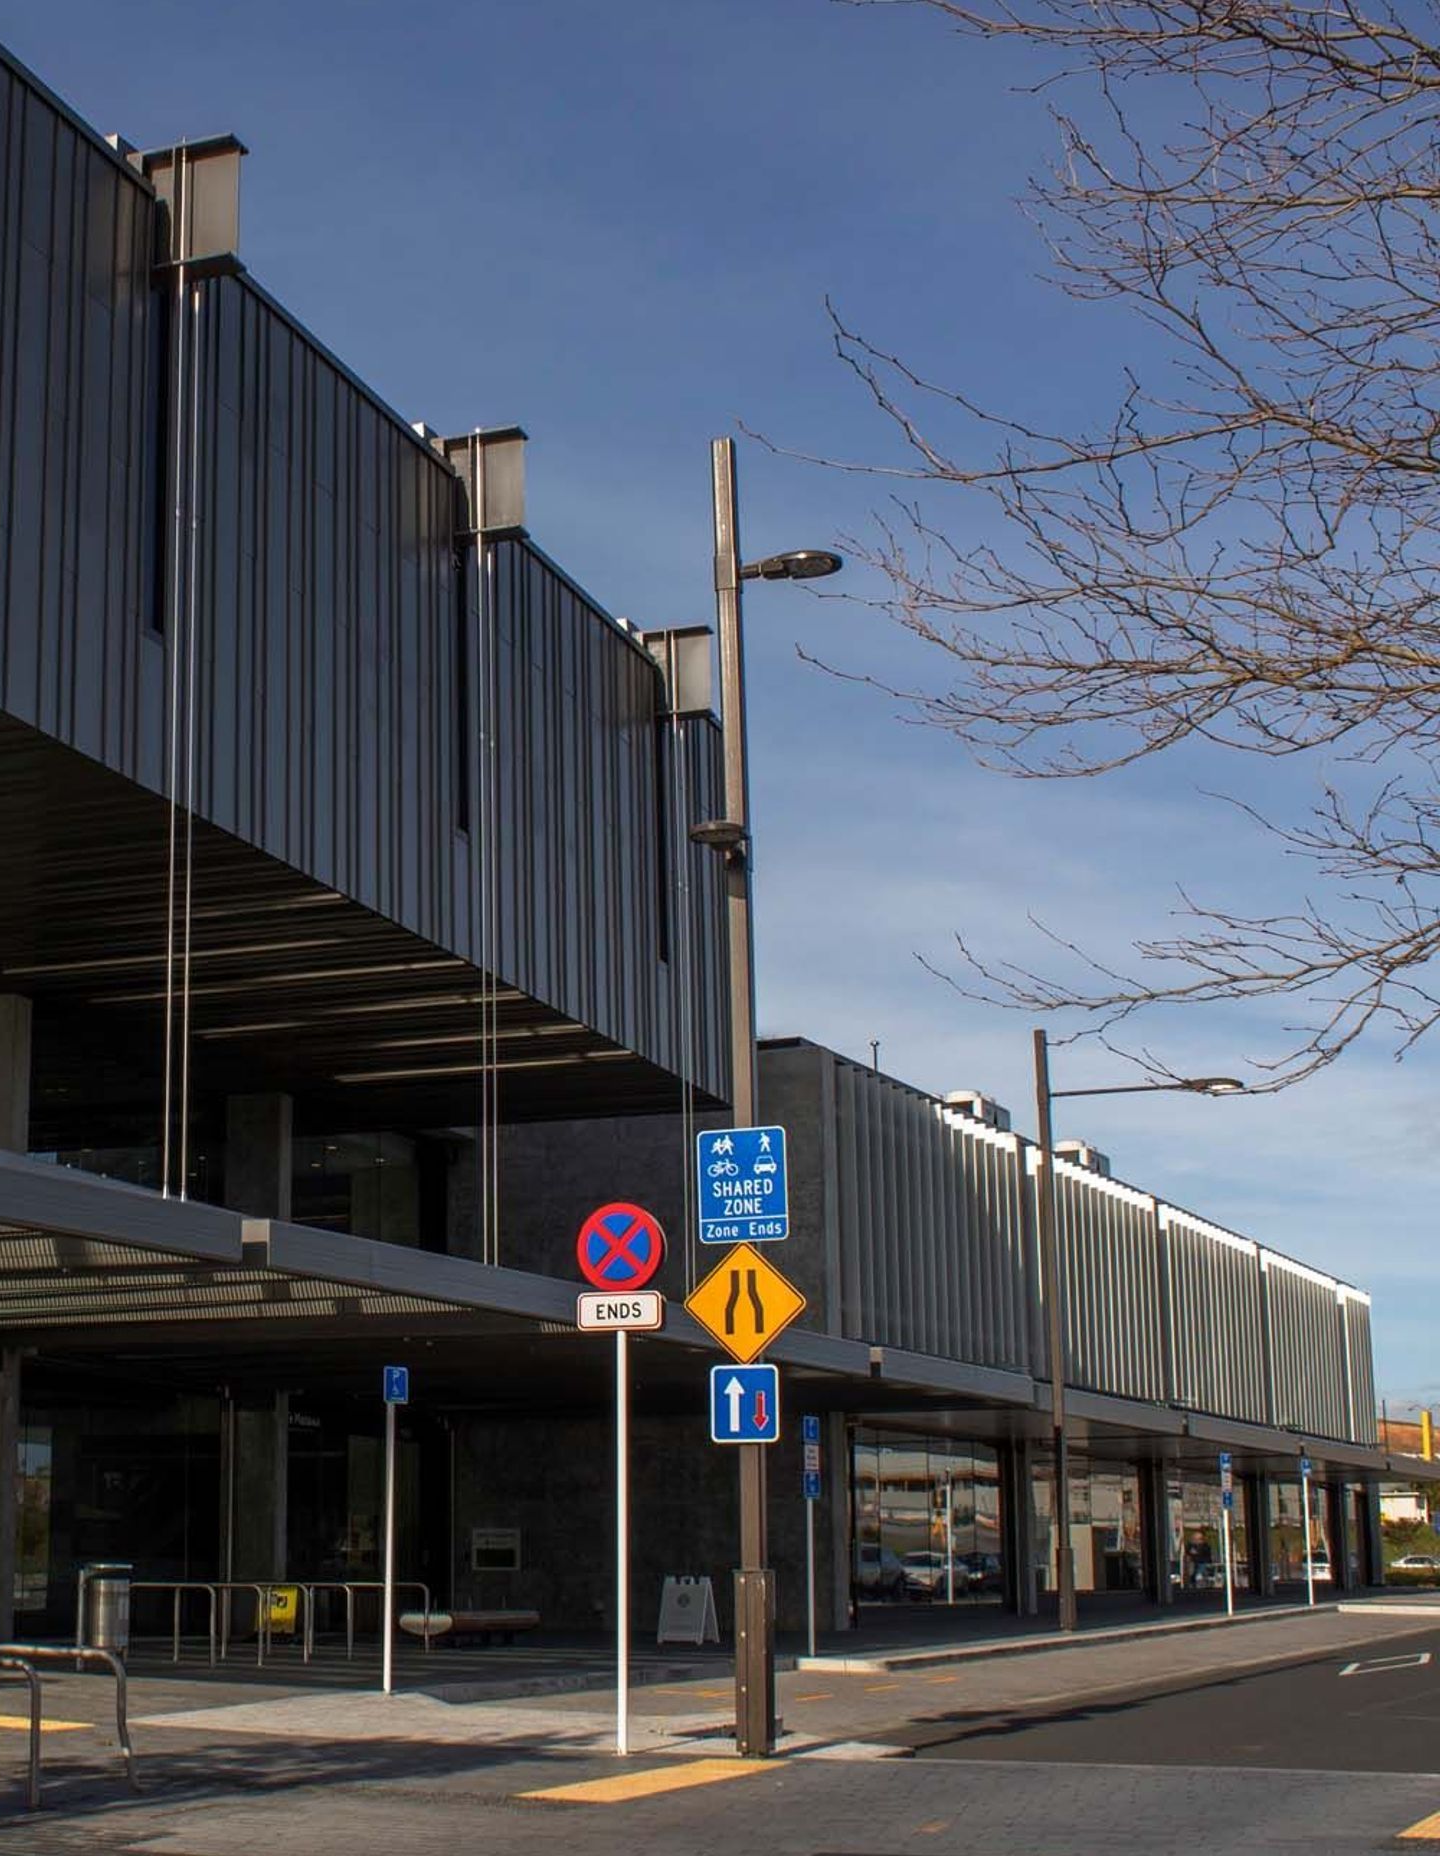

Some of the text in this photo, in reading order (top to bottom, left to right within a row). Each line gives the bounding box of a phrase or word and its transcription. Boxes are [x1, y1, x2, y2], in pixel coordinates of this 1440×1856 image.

[712, 1178, 773, 1197] SHARED
[724, 1198, 763, 1216] ZONE
[706, 1221, 782, 1238] Zone Ends
[595, 1302, 642, 1320] ENDS
